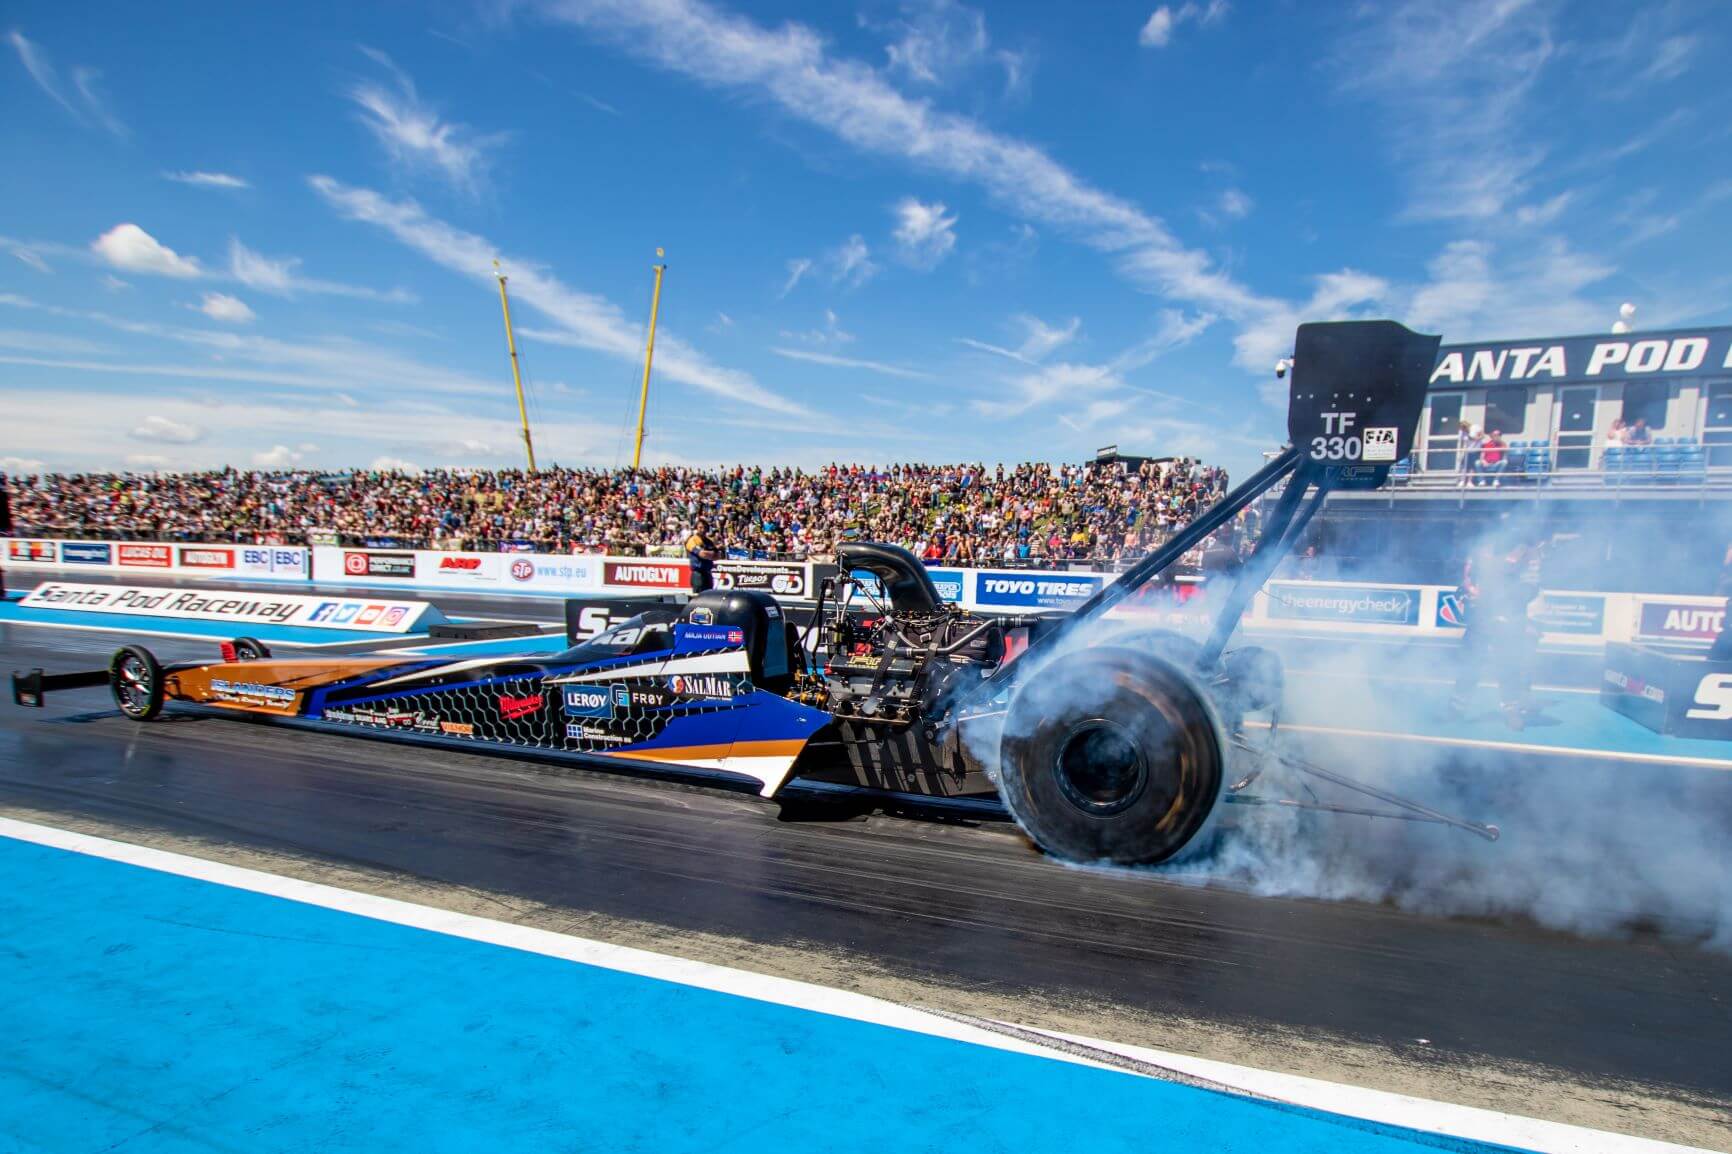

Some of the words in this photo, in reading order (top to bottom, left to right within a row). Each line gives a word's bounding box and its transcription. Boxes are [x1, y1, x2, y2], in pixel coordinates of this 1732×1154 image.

[1585, 337, 1709, 376] POD
[1320, 412, 1356, 434] TF
[1310, 437, 1362, 460] 330
[244, 550, 268, 563] EBC
[275, 551, 300, 565] EBC
[512, 562, 532, 577] STP
[614, 566, 679, 582] AUTOGLYM
[984, 580, 1035, 594] TOYO
[1036, 581, 1094, 596] TIRES
[34, 585, 108, 605] Santa
[108, 589, 173, 609] Pod
[166, 590, 303, 622] Raceway
[567, 692, 608, 708] LERØY
